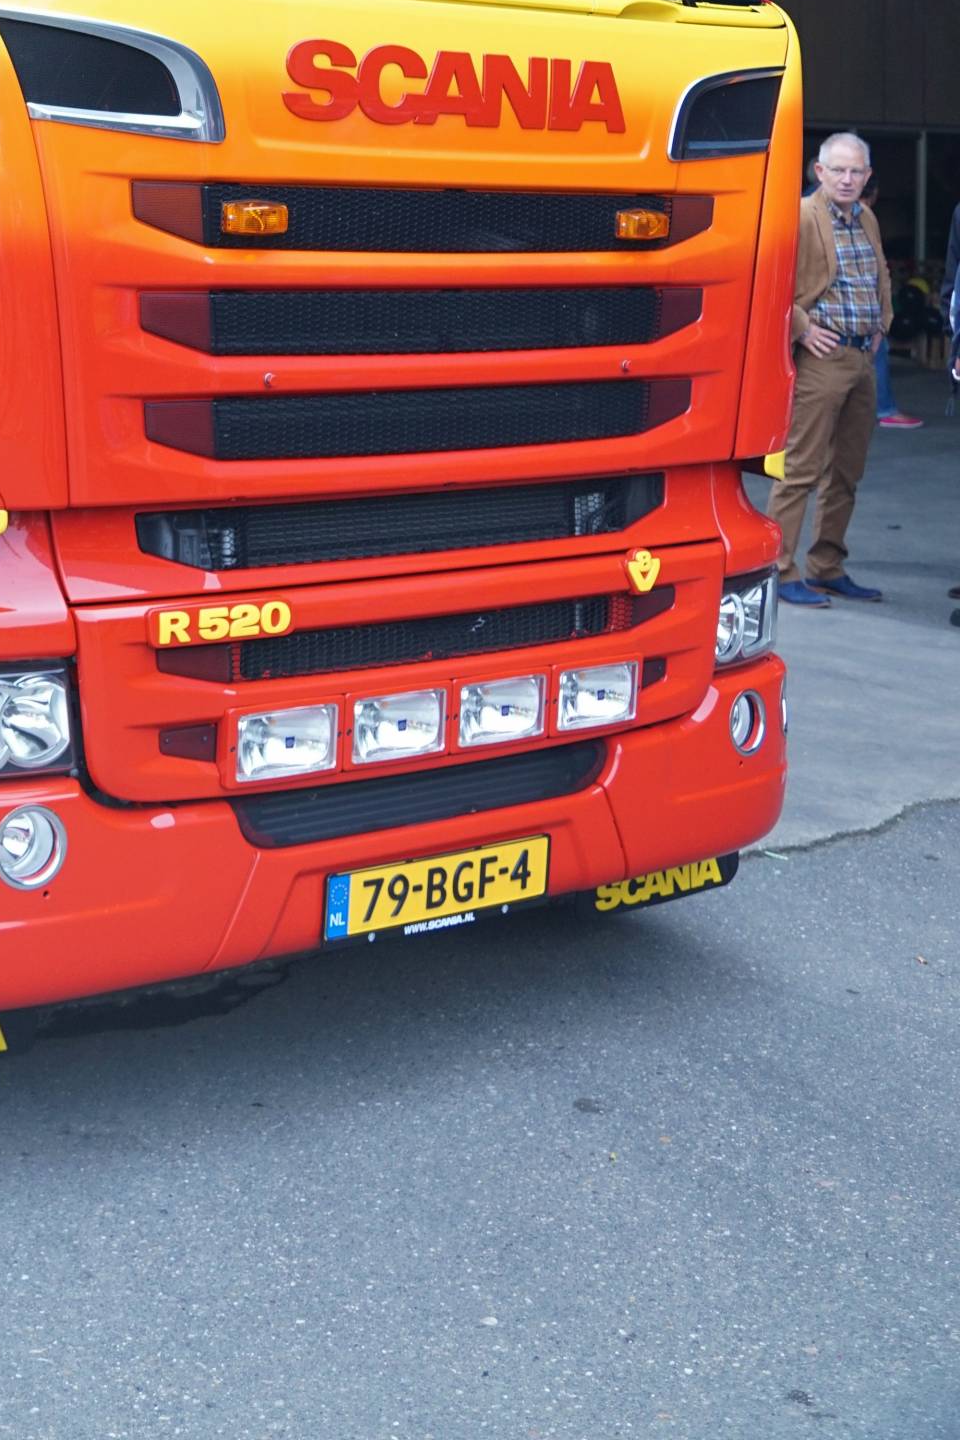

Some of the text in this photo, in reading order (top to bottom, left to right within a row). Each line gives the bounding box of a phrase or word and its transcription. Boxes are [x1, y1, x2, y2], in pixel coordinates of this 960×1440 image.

[281, 39, 627, 134] SCANIA
[159, 601, 291, 645] R 520
[363, 848, 531, 923] 79-BGF-4
[595, 858, 722, 911] SCANIA
[329, 912, 345, 927] NL
[404, 912, 475, 935] WWW.SCANIA.NL
